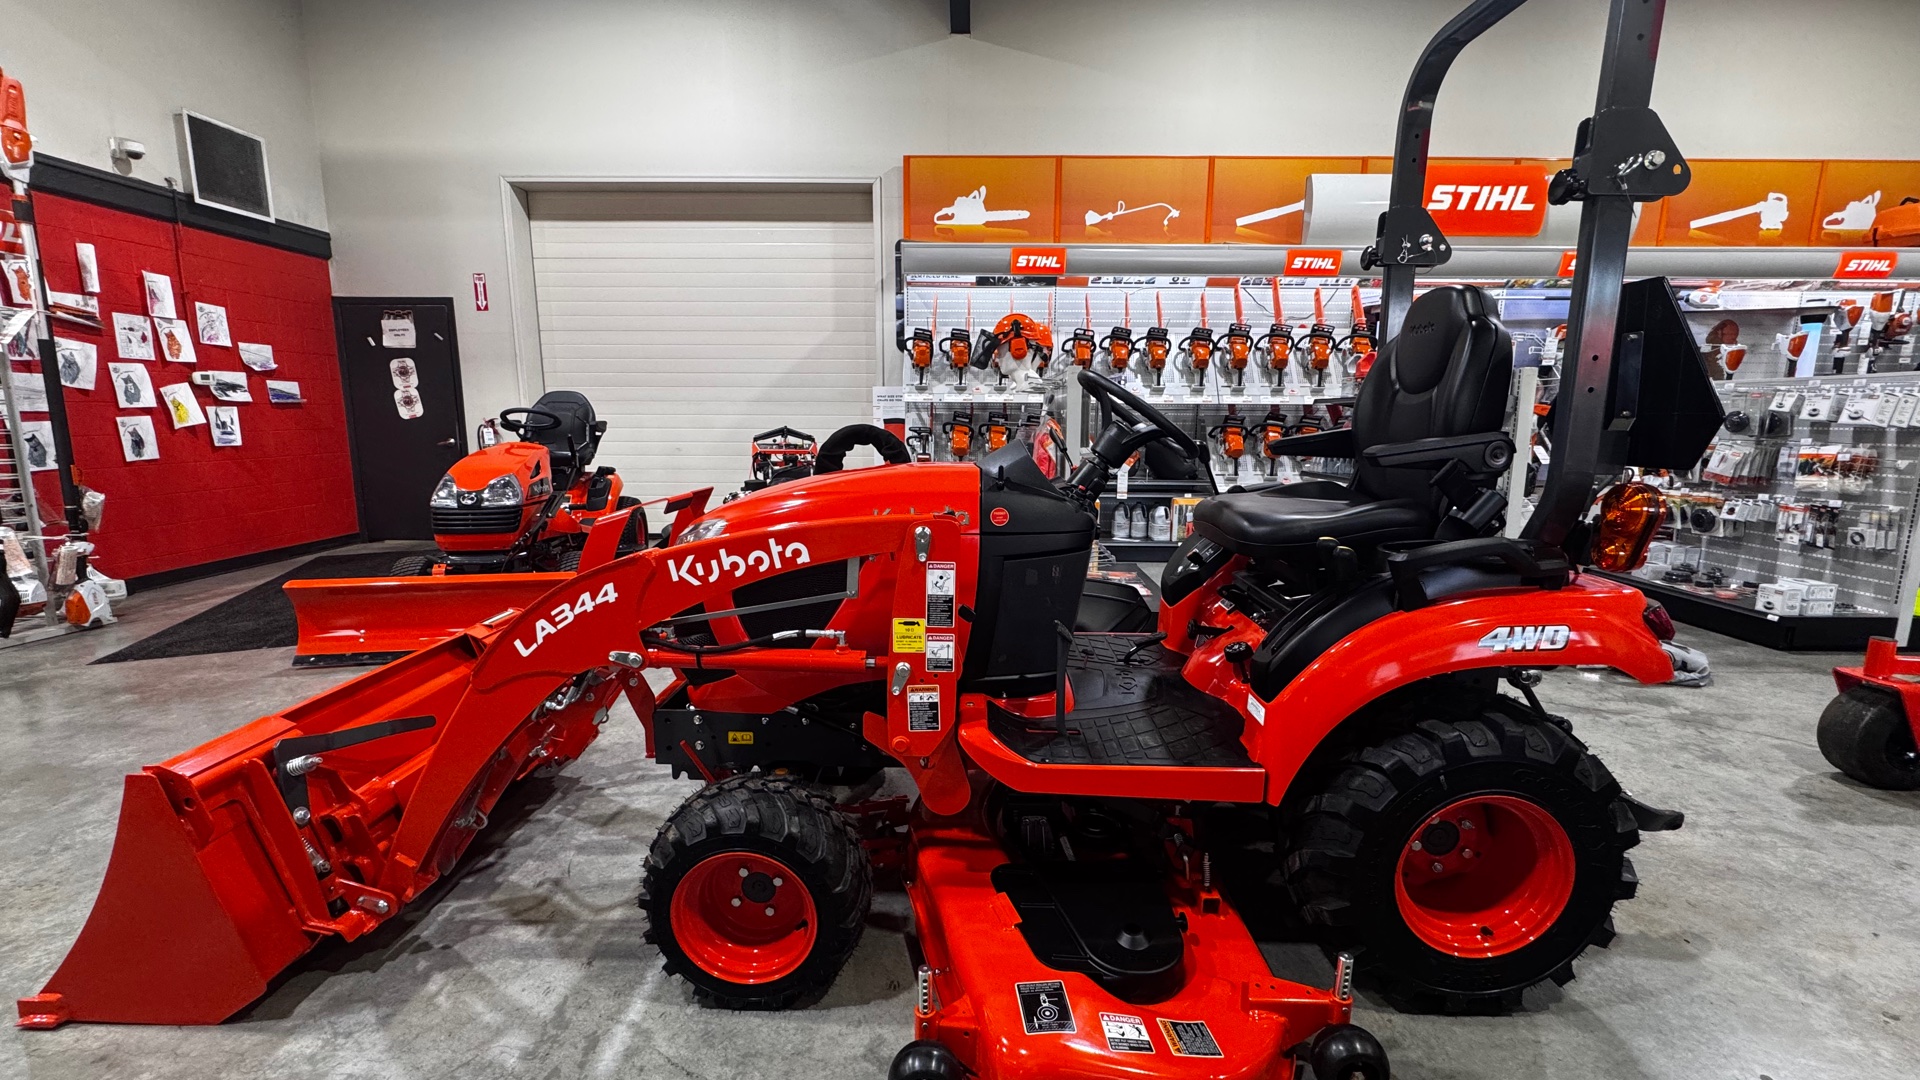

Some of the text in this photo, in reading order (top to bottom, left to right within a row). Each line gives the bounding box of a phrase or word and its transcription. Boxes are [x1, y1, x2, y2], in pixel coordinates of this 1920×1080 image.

[1427, 184, 1536, 211] STIHL
[1016, 255, 1061, 268] STIHL
[1291, 257, 1336, 270] STIHL
[1844, 259, 1891, 272] STIHL
[667, 537, 811, 587] Kubota
[513, 581, 619, 658] LA344
[1478, 625, 1570, 652] 4WD
[1109, 1015, 1142, 1025] DANGER
